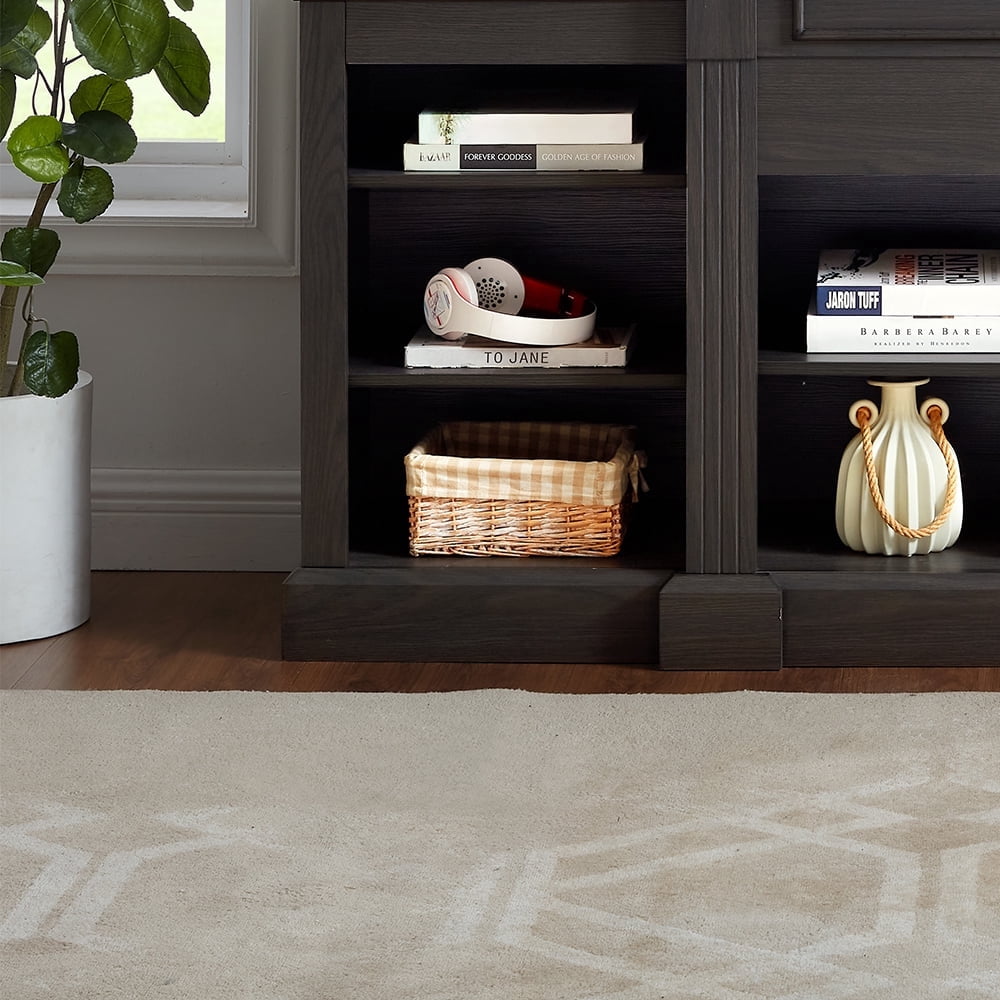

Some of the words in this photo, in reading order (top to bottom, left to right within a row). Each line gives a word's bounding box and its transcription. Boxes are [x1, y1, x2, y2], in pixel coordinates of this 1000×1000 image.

[464, 153, 496, 161] FOREVER
[497, 153, 533, 161] GODDESS
[541, 153, 573, 161] GOLDEN
[574, 153, 589, 161] AGE
[591, 153, 602, 161] OF
[603, 153, 636, 161] FASHION
[945, 254, 979, 285] CHAIN
[825, 290, 857, 309] JARON
[857, 290, 880, 309] TUFF
[860, 327, 935, 336] BARBERA
[942, 327, 992, 336] BAREY
[484, 351, 504, 364] TO
[508, 351, 549, 364] JANE
